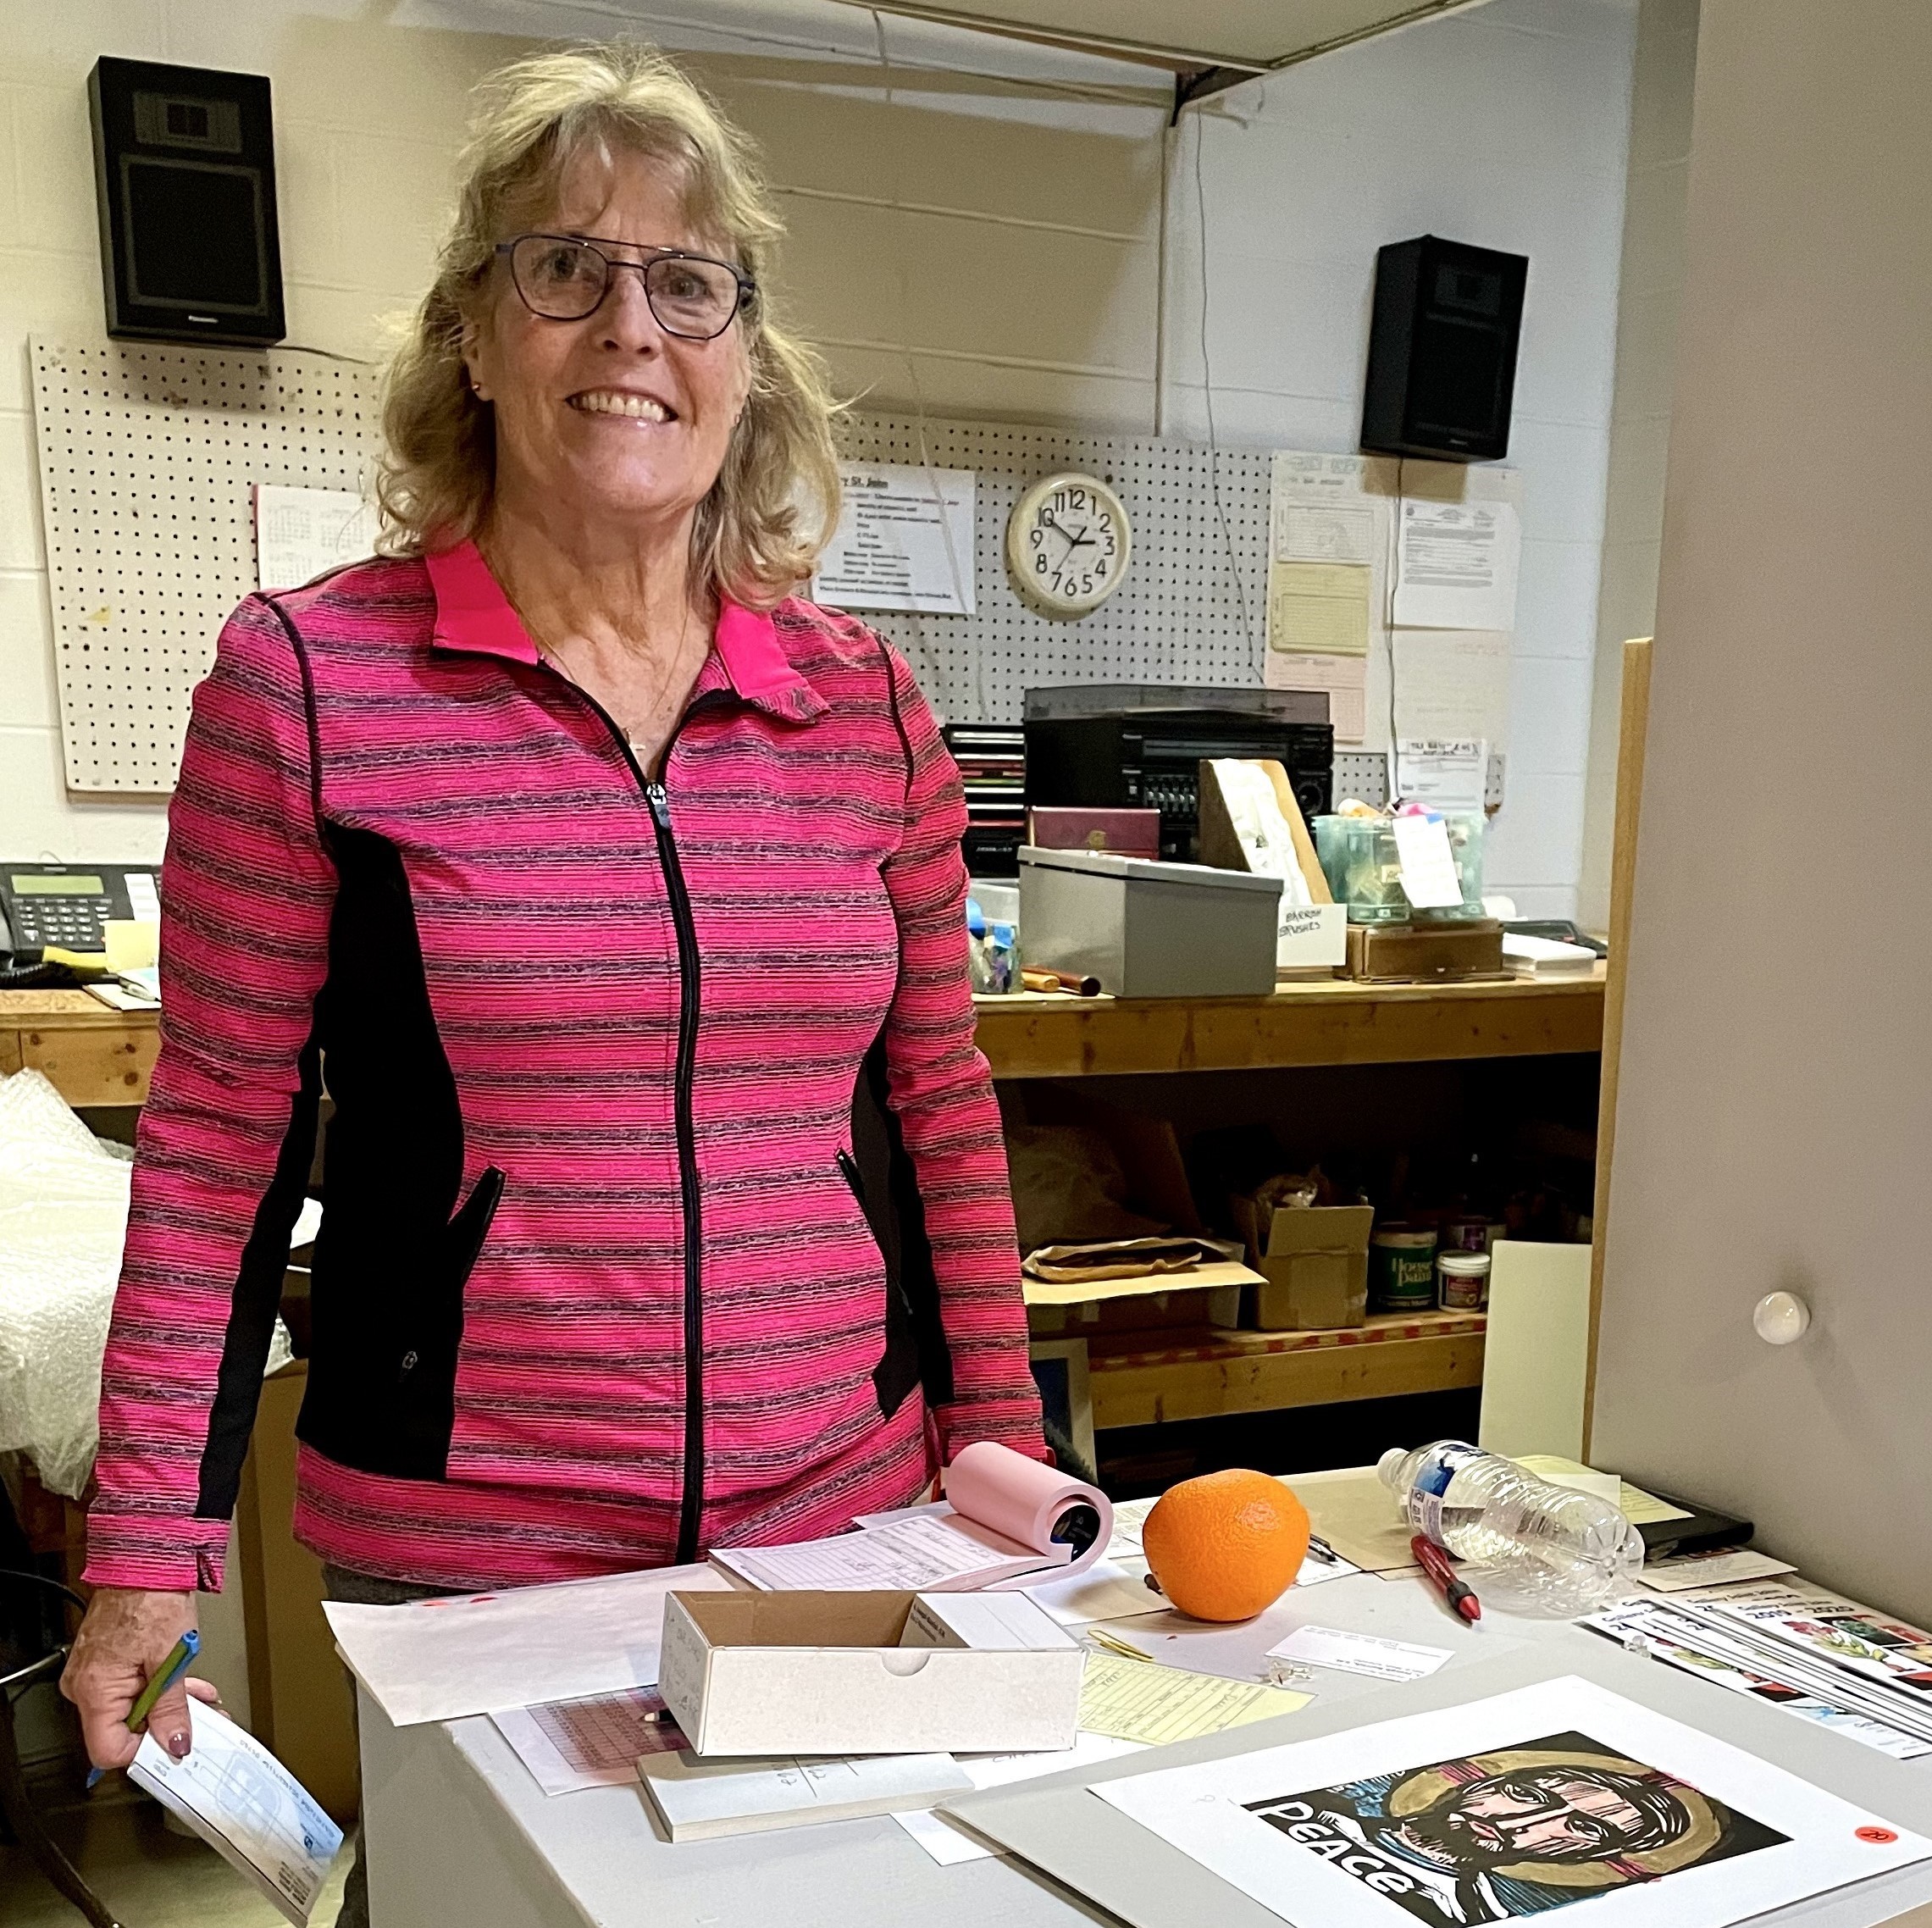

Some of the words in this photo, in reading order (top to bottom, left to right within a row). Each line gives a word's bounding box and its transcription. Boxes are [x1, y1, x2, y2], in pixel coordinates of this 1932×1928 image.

[1055, 492, 1065, 512] 11
[1069, 489, 1085, 509] 12
[1091, 496, 1097, 515] 1
[1038, 507, 1054, 527] 10
[1099, 513, 1110, 533] 2
[1031, 529, 1043, 550] 9
[1104, 536, 1115, 556] 3
[1036, 553, 1048, 573] 8
[1094, 559, 1107, 578] 4
[1052, 572, 1062, 591] 7
[1065, 577, 1077, 596] 6
[1082, 574, 1093, 594] 5
[1804, 1605, 1855, 1614] 2020
